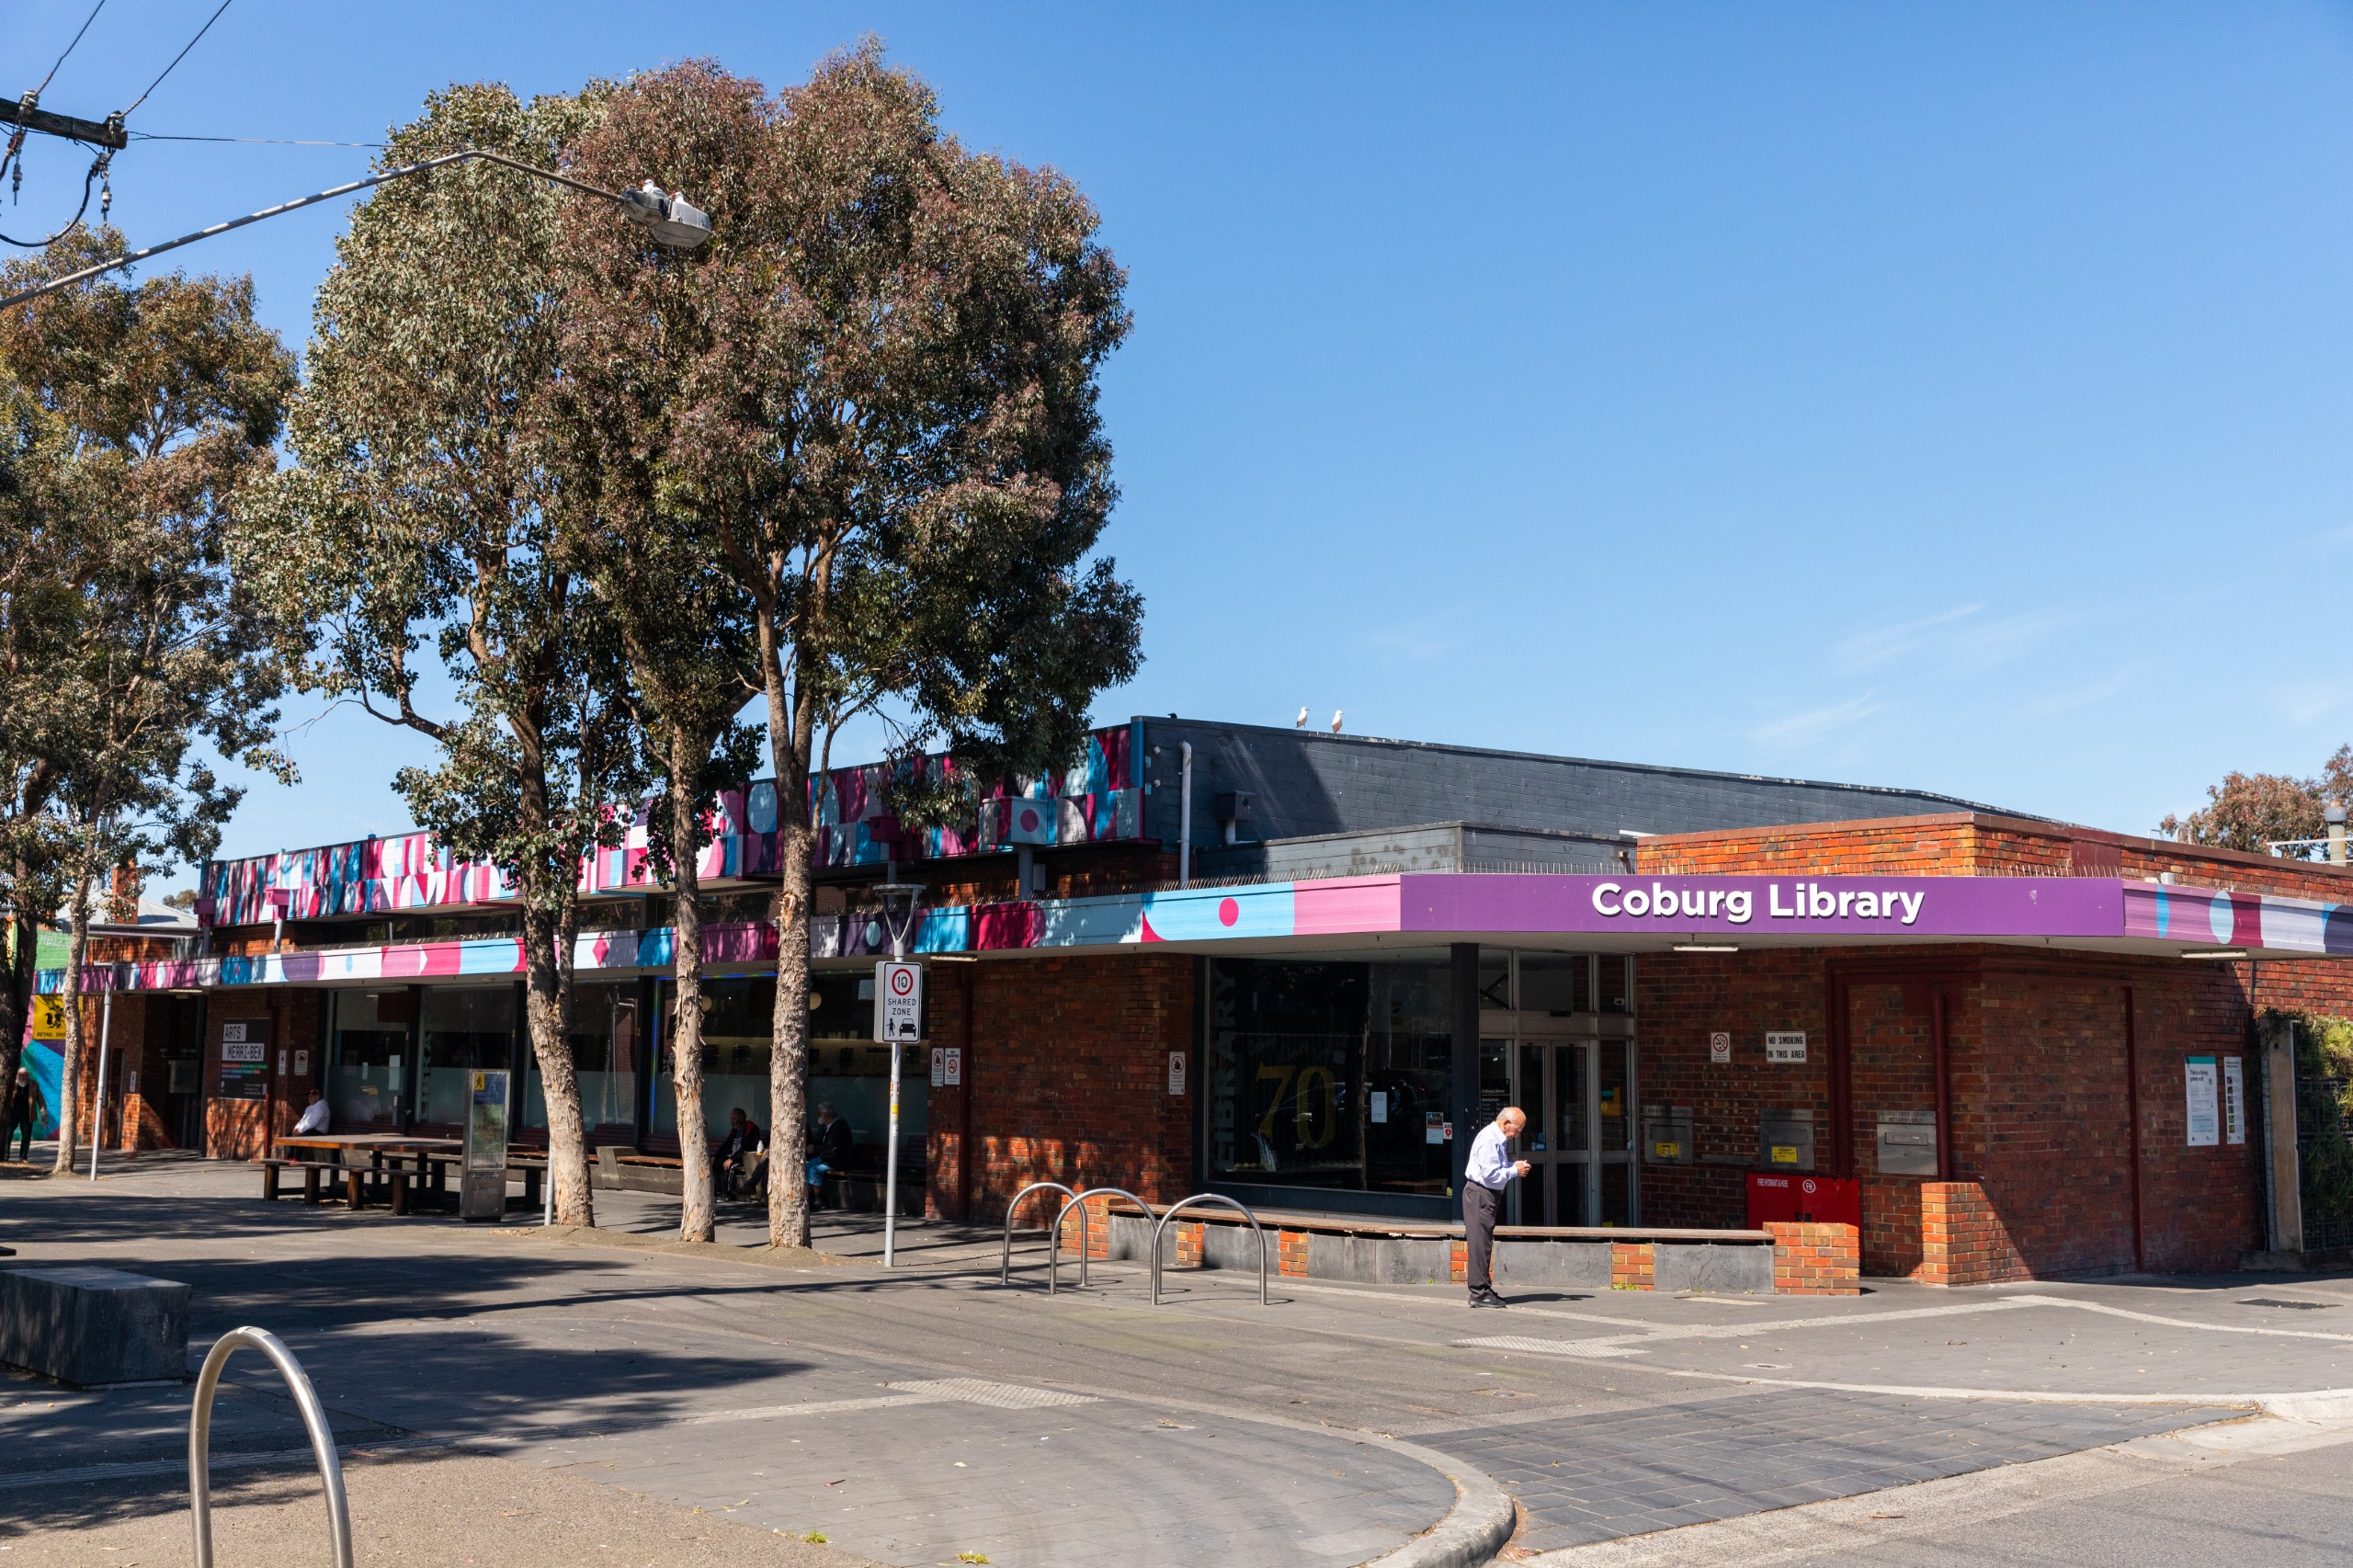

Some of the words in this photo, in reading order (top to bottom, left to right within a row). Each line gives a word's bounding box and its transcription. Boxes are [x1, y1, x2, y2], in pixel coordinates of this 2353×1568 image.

[1592, 882, 1753, 923] Coburg
[1769, 883, 1926, 925] Library
[897, 976, 908, 988] 10
[225, 1026, 242, 1040] ARTS
[1768, 1036, 1776, 1044] NO
[1779, 1036, 1803, 1045] SMOKING
[227, 1045, 264, 1060] MERRI-BEK
[1791, 1051, 1804, 1059] AREA
[1213, 966, 1236, 1171] LIBRARY
[1256, 1062, 1336, 1149] 70
